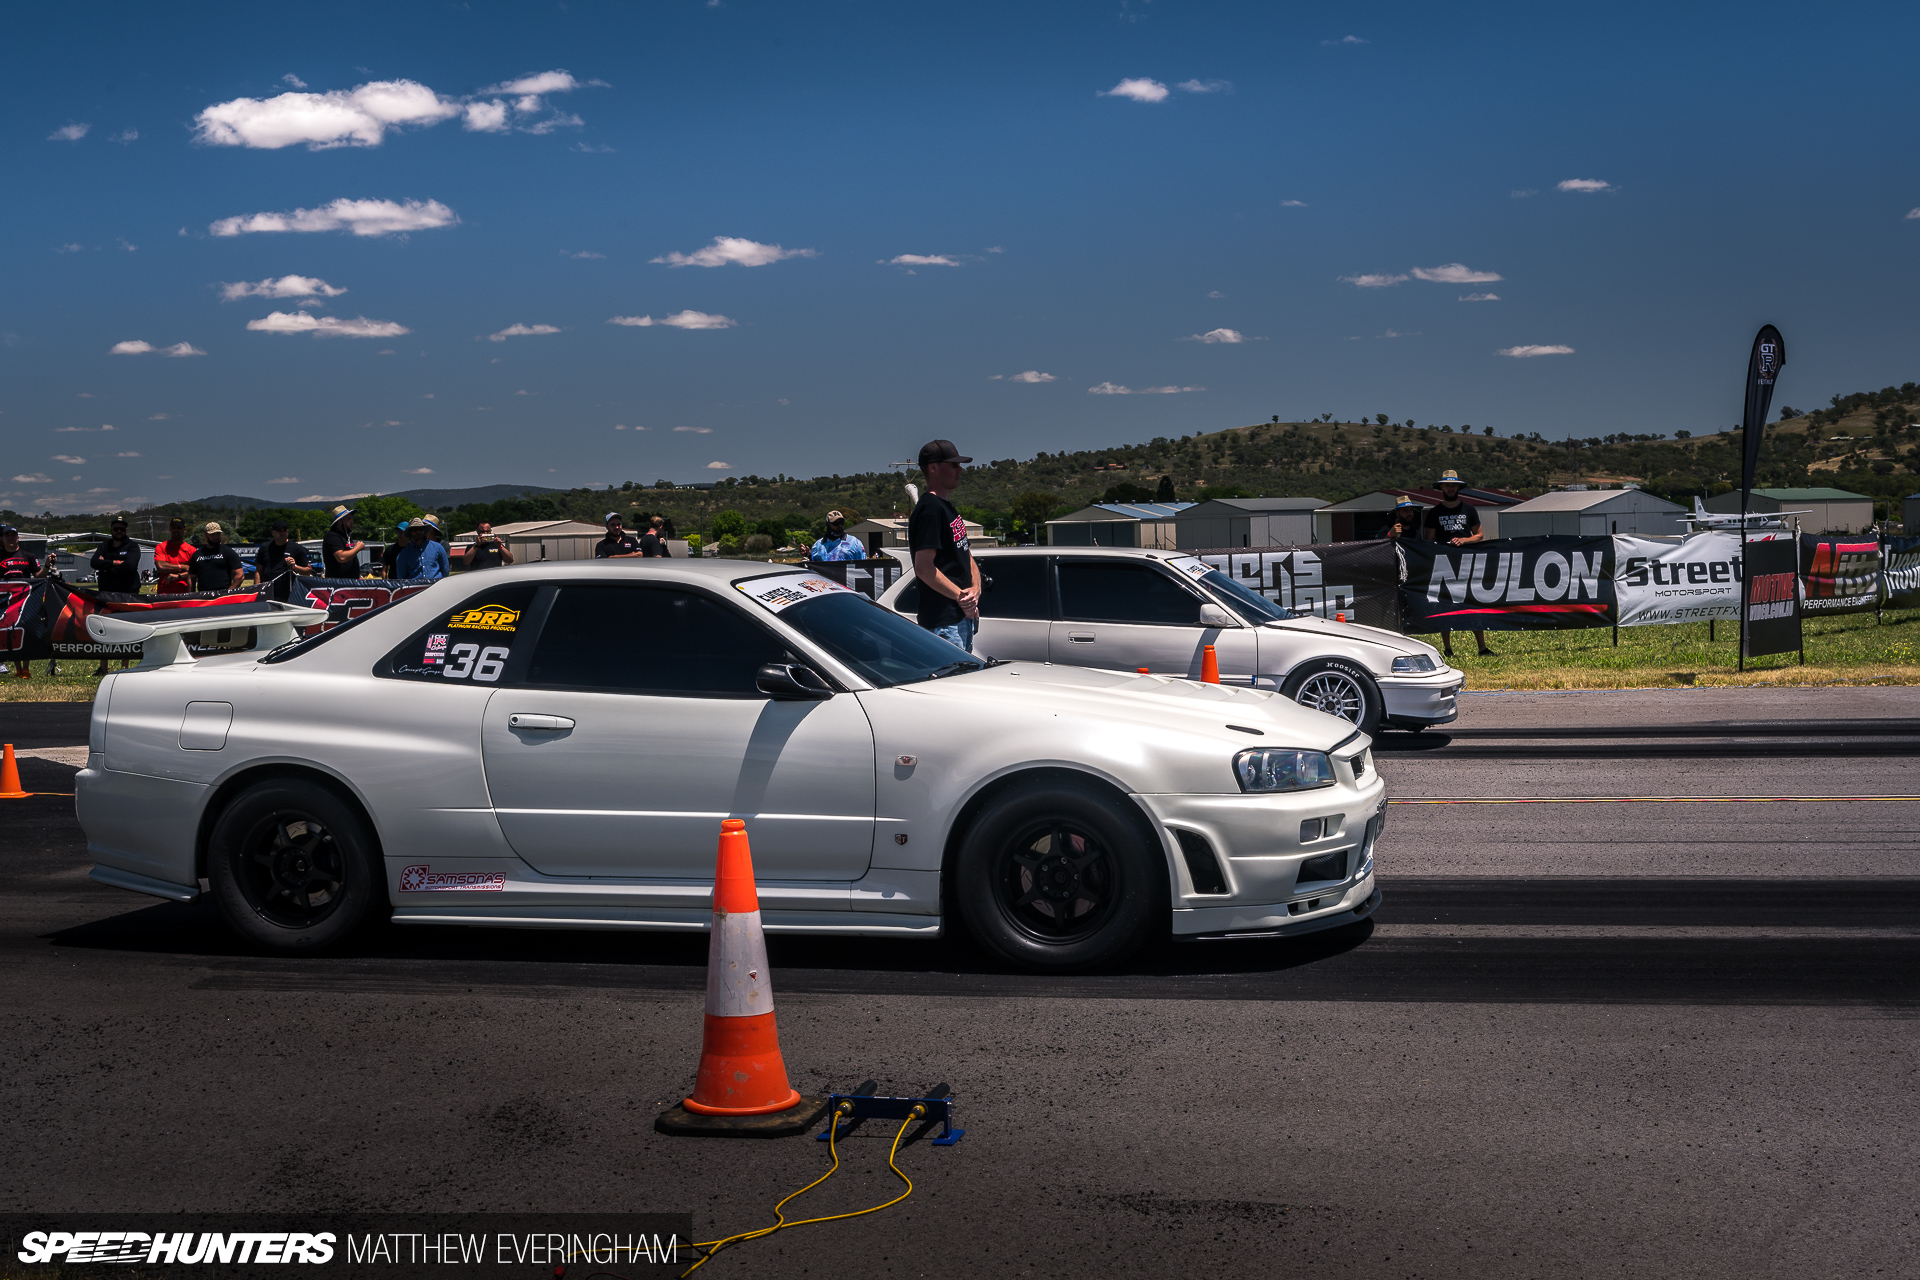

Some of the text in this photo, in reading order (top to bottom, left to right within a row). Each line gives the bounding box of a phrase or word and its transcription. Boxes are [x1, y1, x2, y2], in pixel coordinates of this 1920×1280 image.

[1761, 344, 1775, 353] GT
[1761, 353, 1774, 372] R
[1427, 551, 1603, 604] NULON
[1626, 556, 1743, 587] Street
[1655, 588, 1732, 597] MOTORSPORT
[1750, 572, 1795, 604] MOTIVE
[1803, 597, 1852, 609] PERFORMANCE
[464, 612, 516, 625] PRP
[52, 643, 144, 653] PERFORMANC
[443, 643, 510, 681] 36
[426, 874, 504, 885] SAMSONAS
